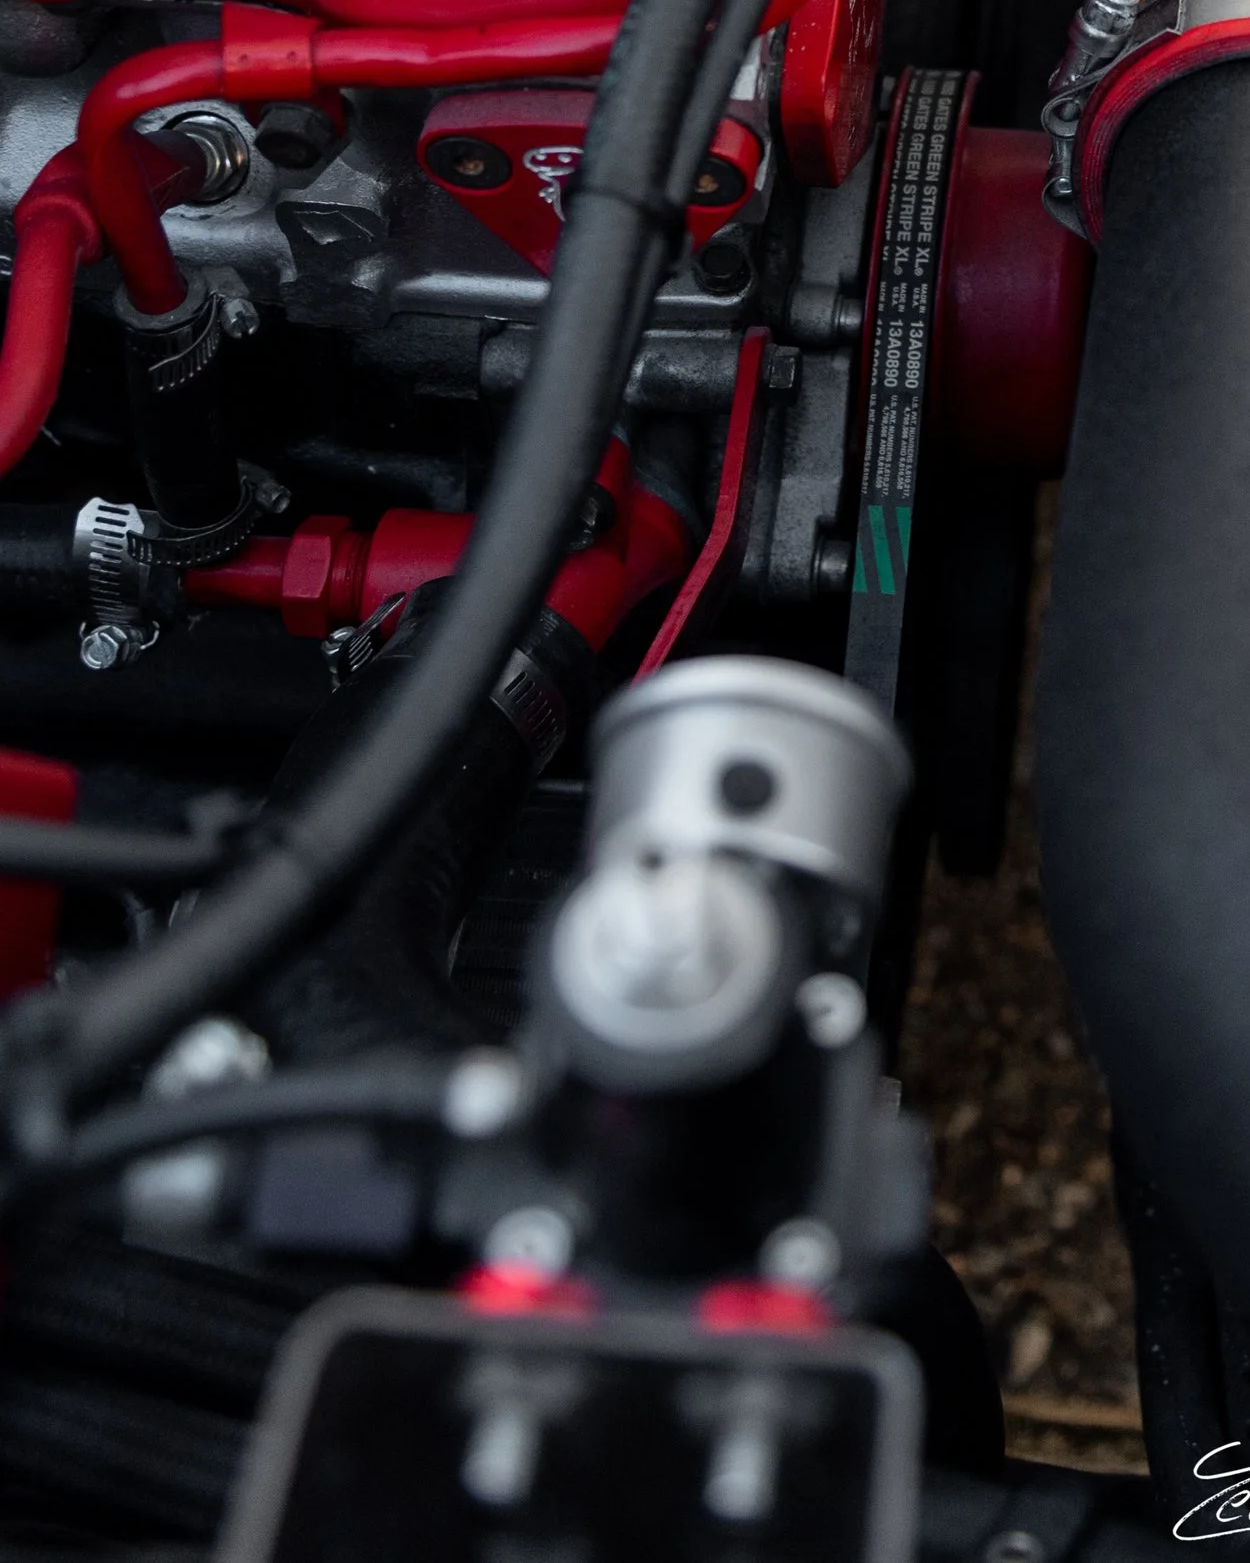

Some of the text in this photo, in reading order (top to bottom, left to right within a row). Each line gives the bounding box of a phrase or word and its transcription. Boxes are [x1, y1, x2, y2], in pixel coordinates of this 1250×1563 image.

[912, 97, 932, 130] GATES
[933, 97, 952, 131] GATES
[903, 133, 924, 180] GREEN
[924, 134, 945, 181] GREEN
[897, 184, 917, 241] STRIPE
[918, 185, 937, 242] STRIPE
[898, 282, 907, 313] MADE IN
[919, 283, 928, 314] MADE IN
[884, 319, 903, 387] 13A0890
[905, 320, 924, 388] 13A0890
[879, 439, 887, 455] AND
[885, 426, 895, 462] NUMBERS
[906, 427, 916, 463] NUMBERS
